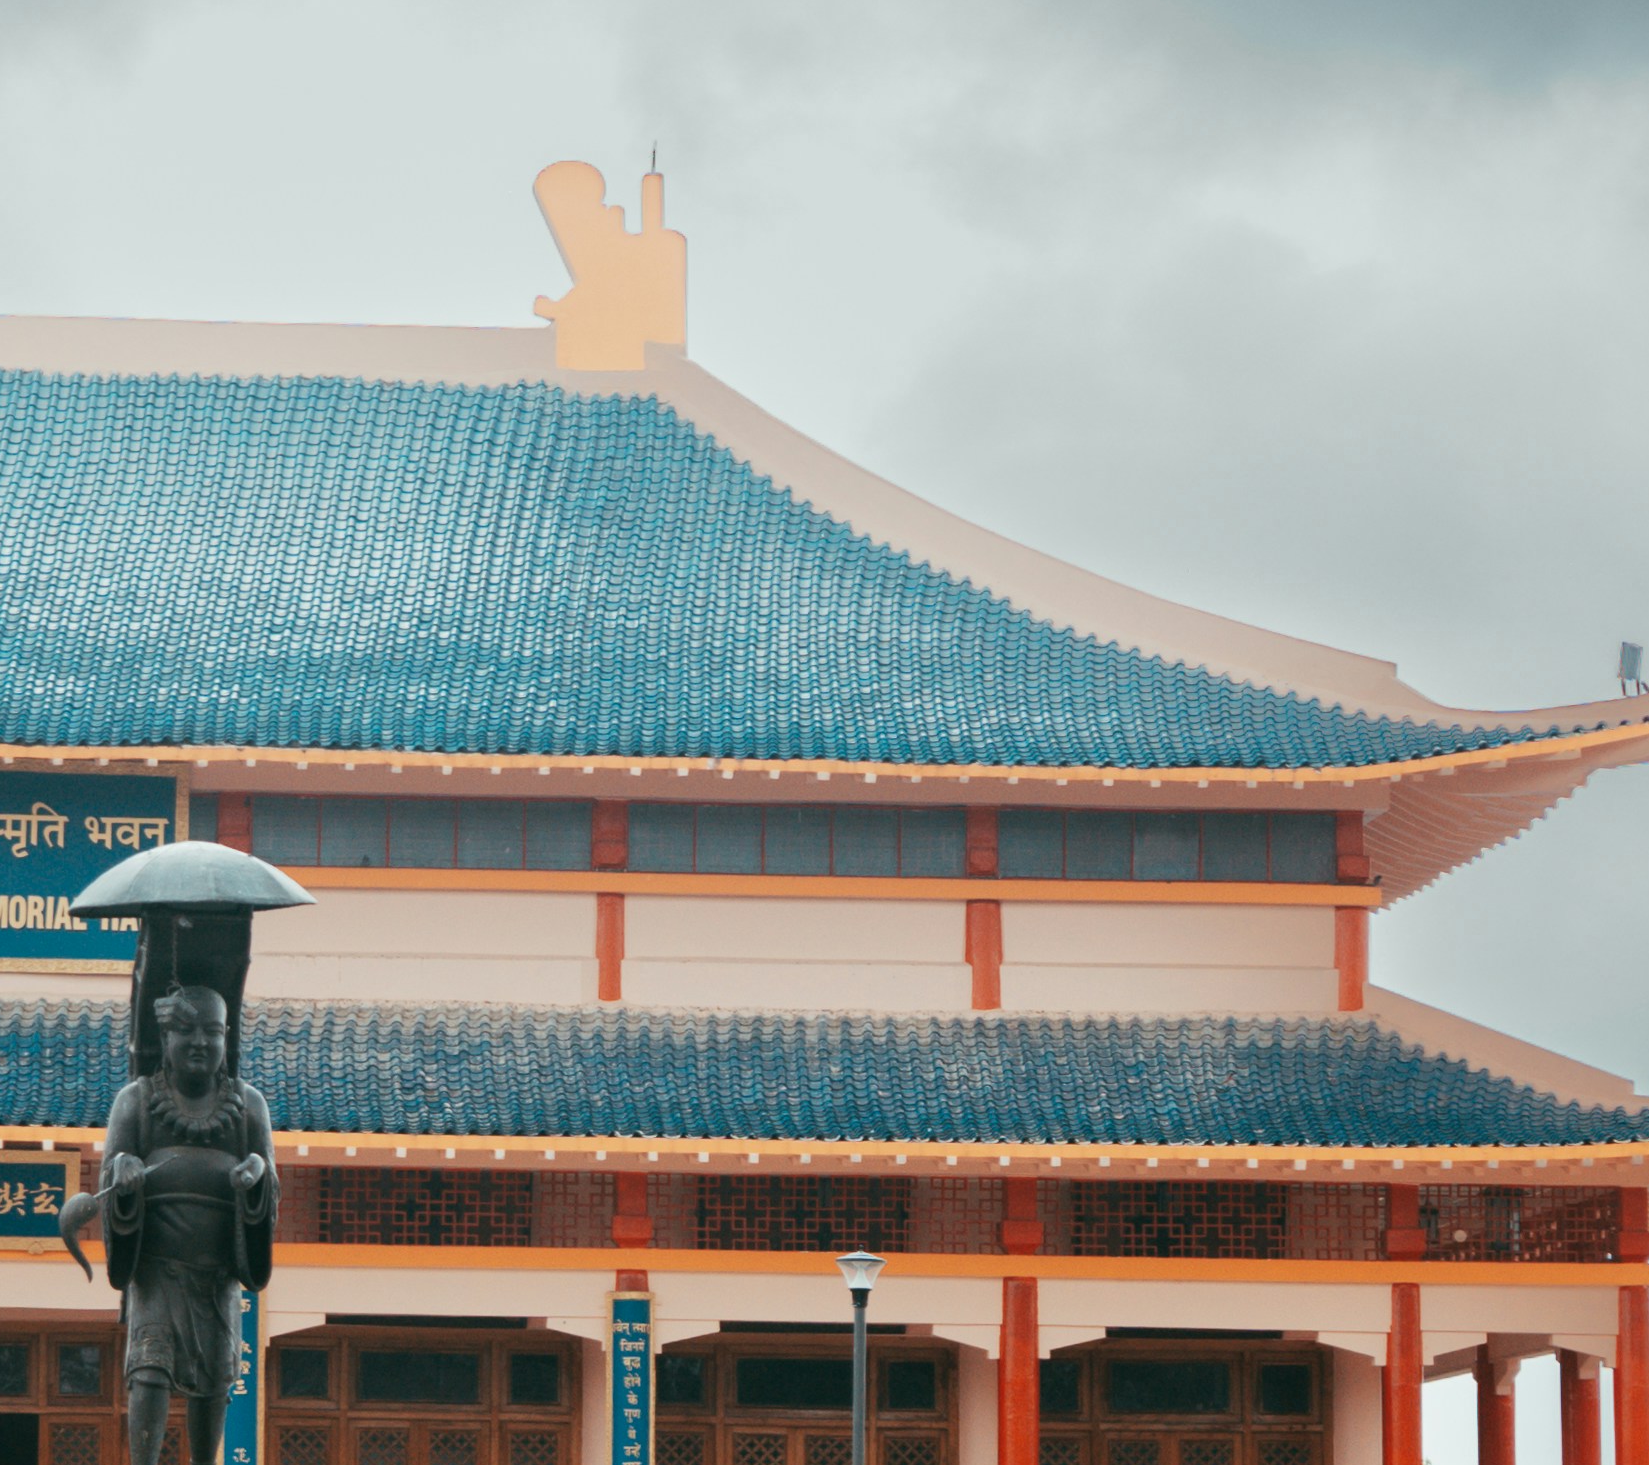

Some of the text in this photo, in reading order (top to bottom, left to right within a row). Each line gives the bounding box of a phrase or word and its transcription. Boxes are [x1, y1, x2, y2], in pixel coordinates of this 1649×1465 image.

[84, 816, 169, 850] भवन
[623, 1356, 641, 1372] बुद्ध
[624, 1373, 641, 1388] होने
[627, 1391, 638, 1405] के
[624, 1408, 641, 1423] गुण
